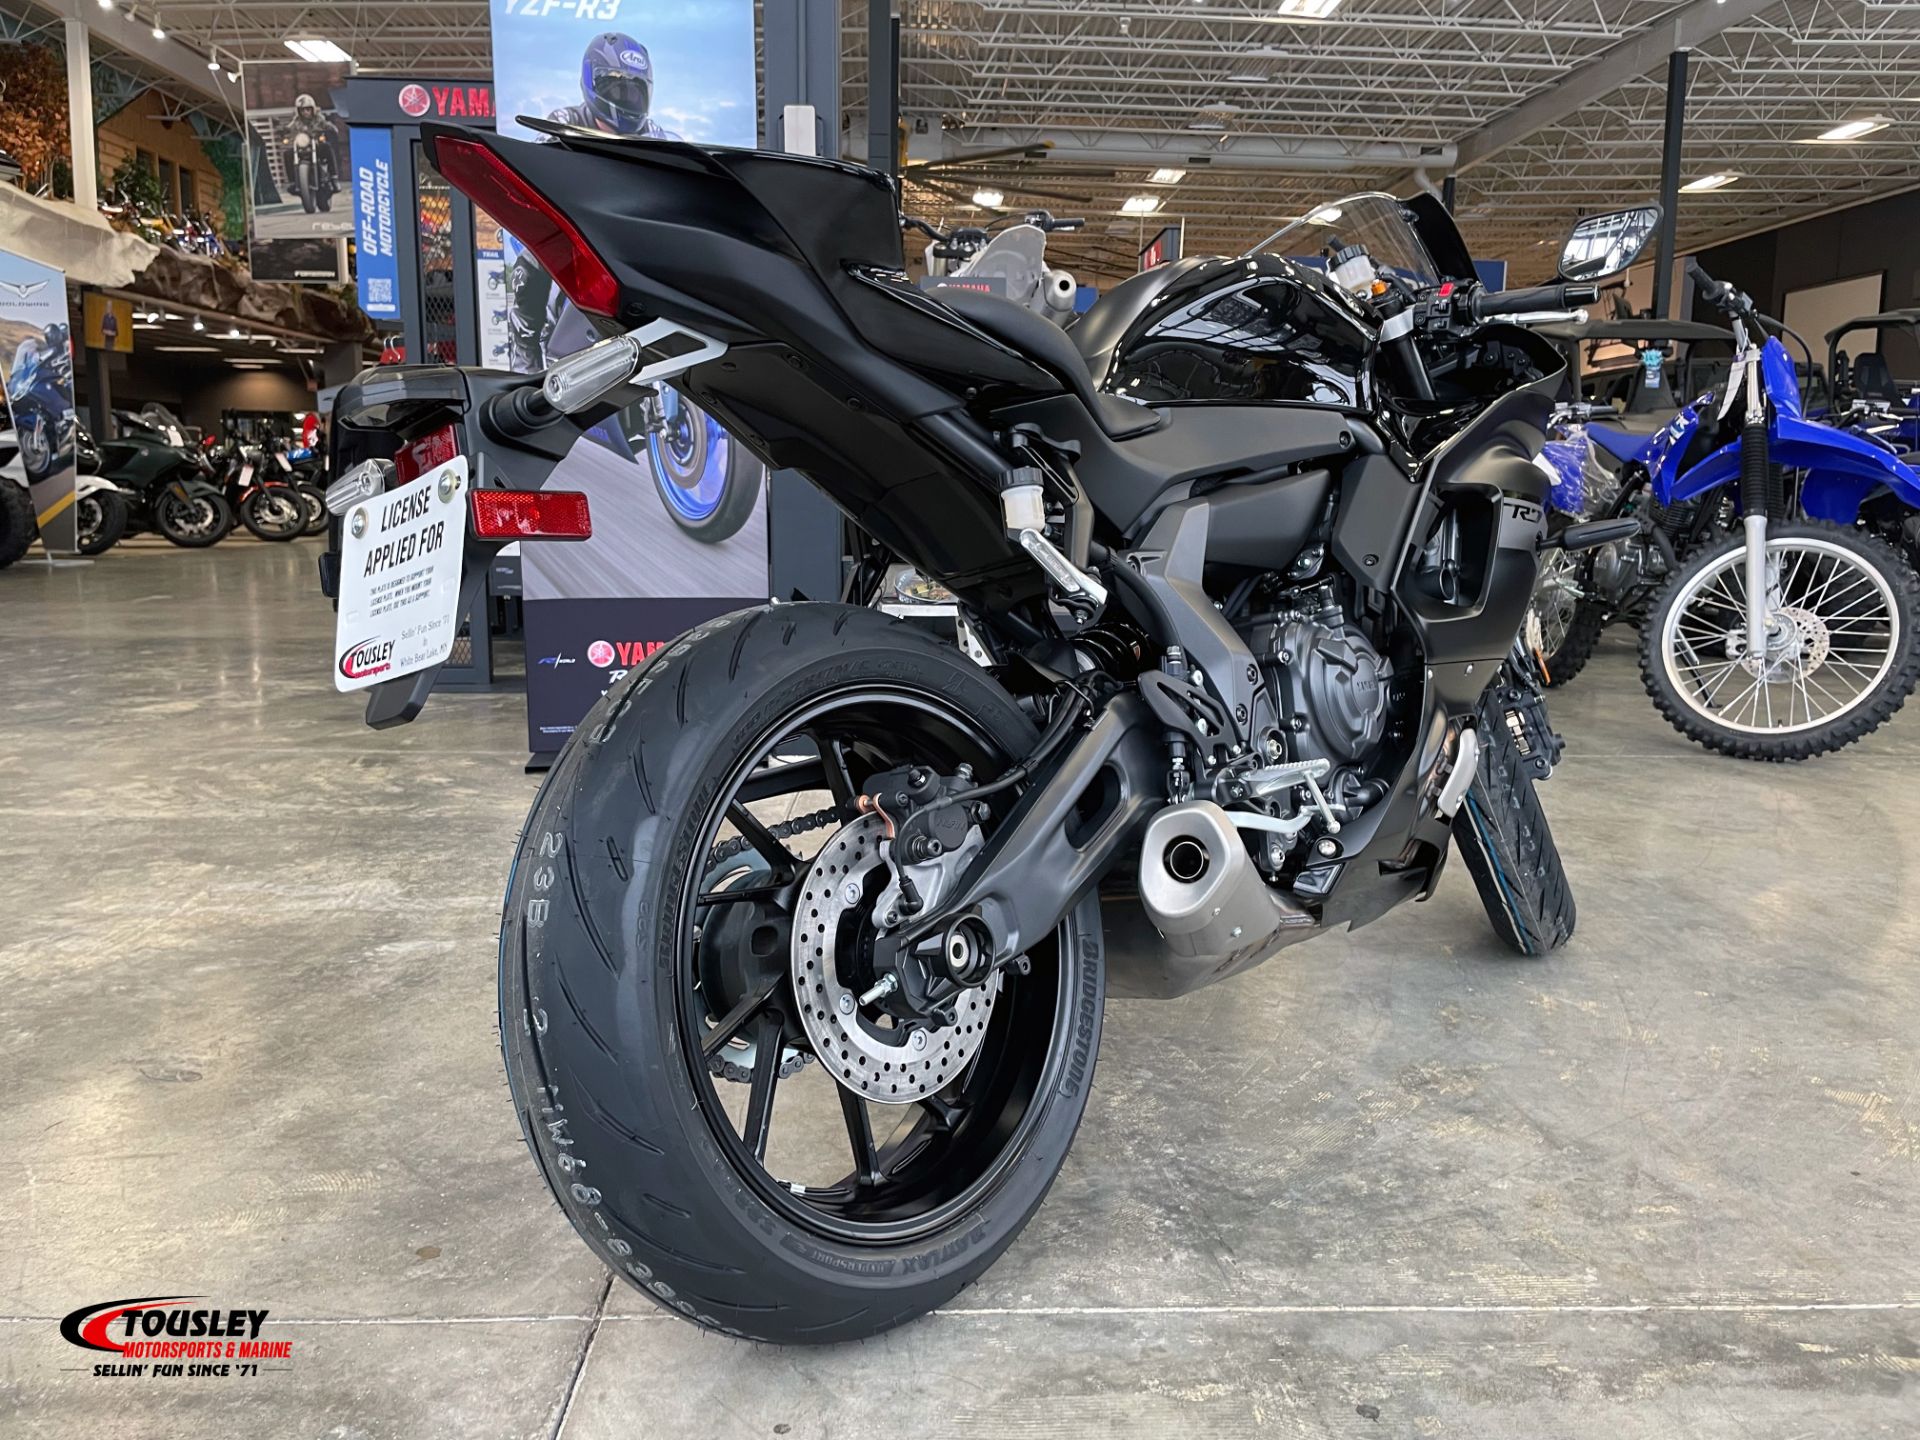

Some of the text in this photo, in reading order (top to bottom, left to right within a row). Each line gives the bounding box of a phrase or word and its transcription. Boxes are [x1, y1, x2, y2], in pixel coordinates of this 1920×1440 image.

[622, 51, 646, 66] Arai
[431, 86, 496, 117] YAM
[359, 166, 378, 257] OFF-ROAD
[375, 158, 393, 257] MOTORCYCLE
[380, 485, 432, 533] LICENSE
[363, 520, 445, 578] APPLIED FOR
[417, 623, 427, 636] Fun
[428, 620, 442, 632] Since
[350, 639, 396, 673] TOUSLEY
[414, 653, 425, 665] Bear
[1064, 939, 1099, 1099] BRIDGESTONE
